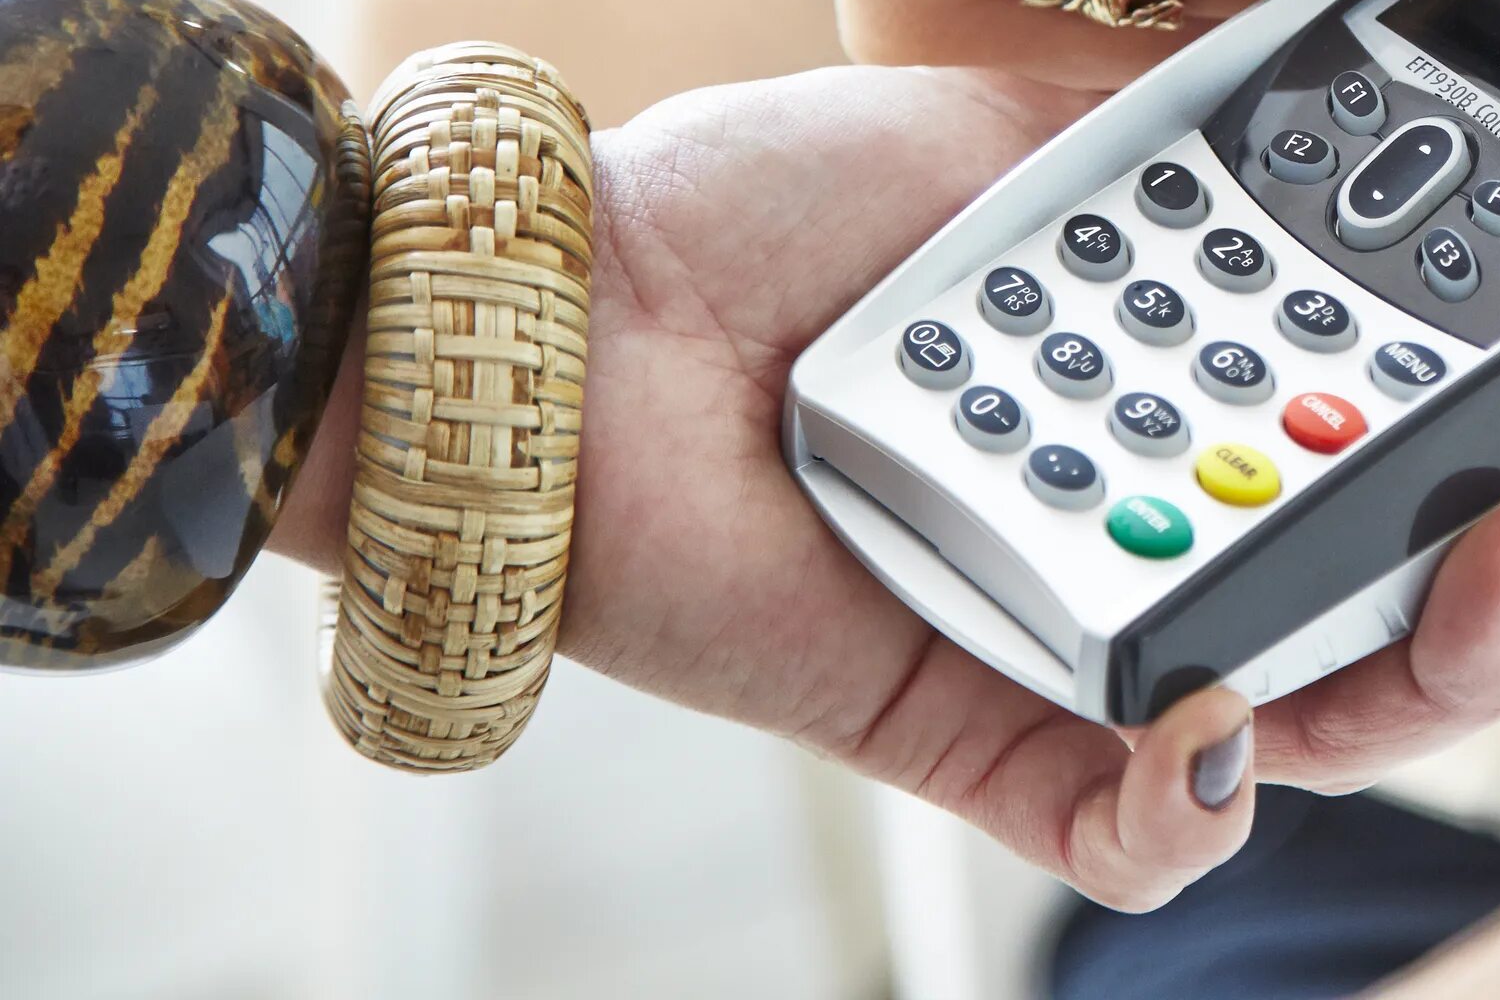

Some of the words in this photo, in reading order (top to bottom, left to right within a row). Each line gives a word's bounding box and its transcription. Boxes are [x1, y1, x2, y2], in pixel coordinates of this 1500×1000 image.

[1341, 80, 1367, 105] F1
[1405, 56, 1478, 108] EFT930B
[1283, 133, 1315, 157] F2
[1150, 169, 1177, 187] 1
[1074, 226, 1102, 243] 4
[1212, 237, 1244, 259] 2
[1432, 238, 1461, 268] F3
[992, 274, 1025, 293] 7
[1134, 287, 1166, 309] 5
[1294, 295, 1326, 316] 3
[1052, 340, 1083, 363] 8
[1212, 348, 1244, 369] 6
[1385, 342, 1436, 384] MENU
[970, 394, 1000, 415] 0
[1125, 398, 1157, 419] 9
[1301, 395, 1347, 431] CANCEL
[1215, 448, 1258, 480] CLEAR
[1126, 498, 1172, 533] ENTER
